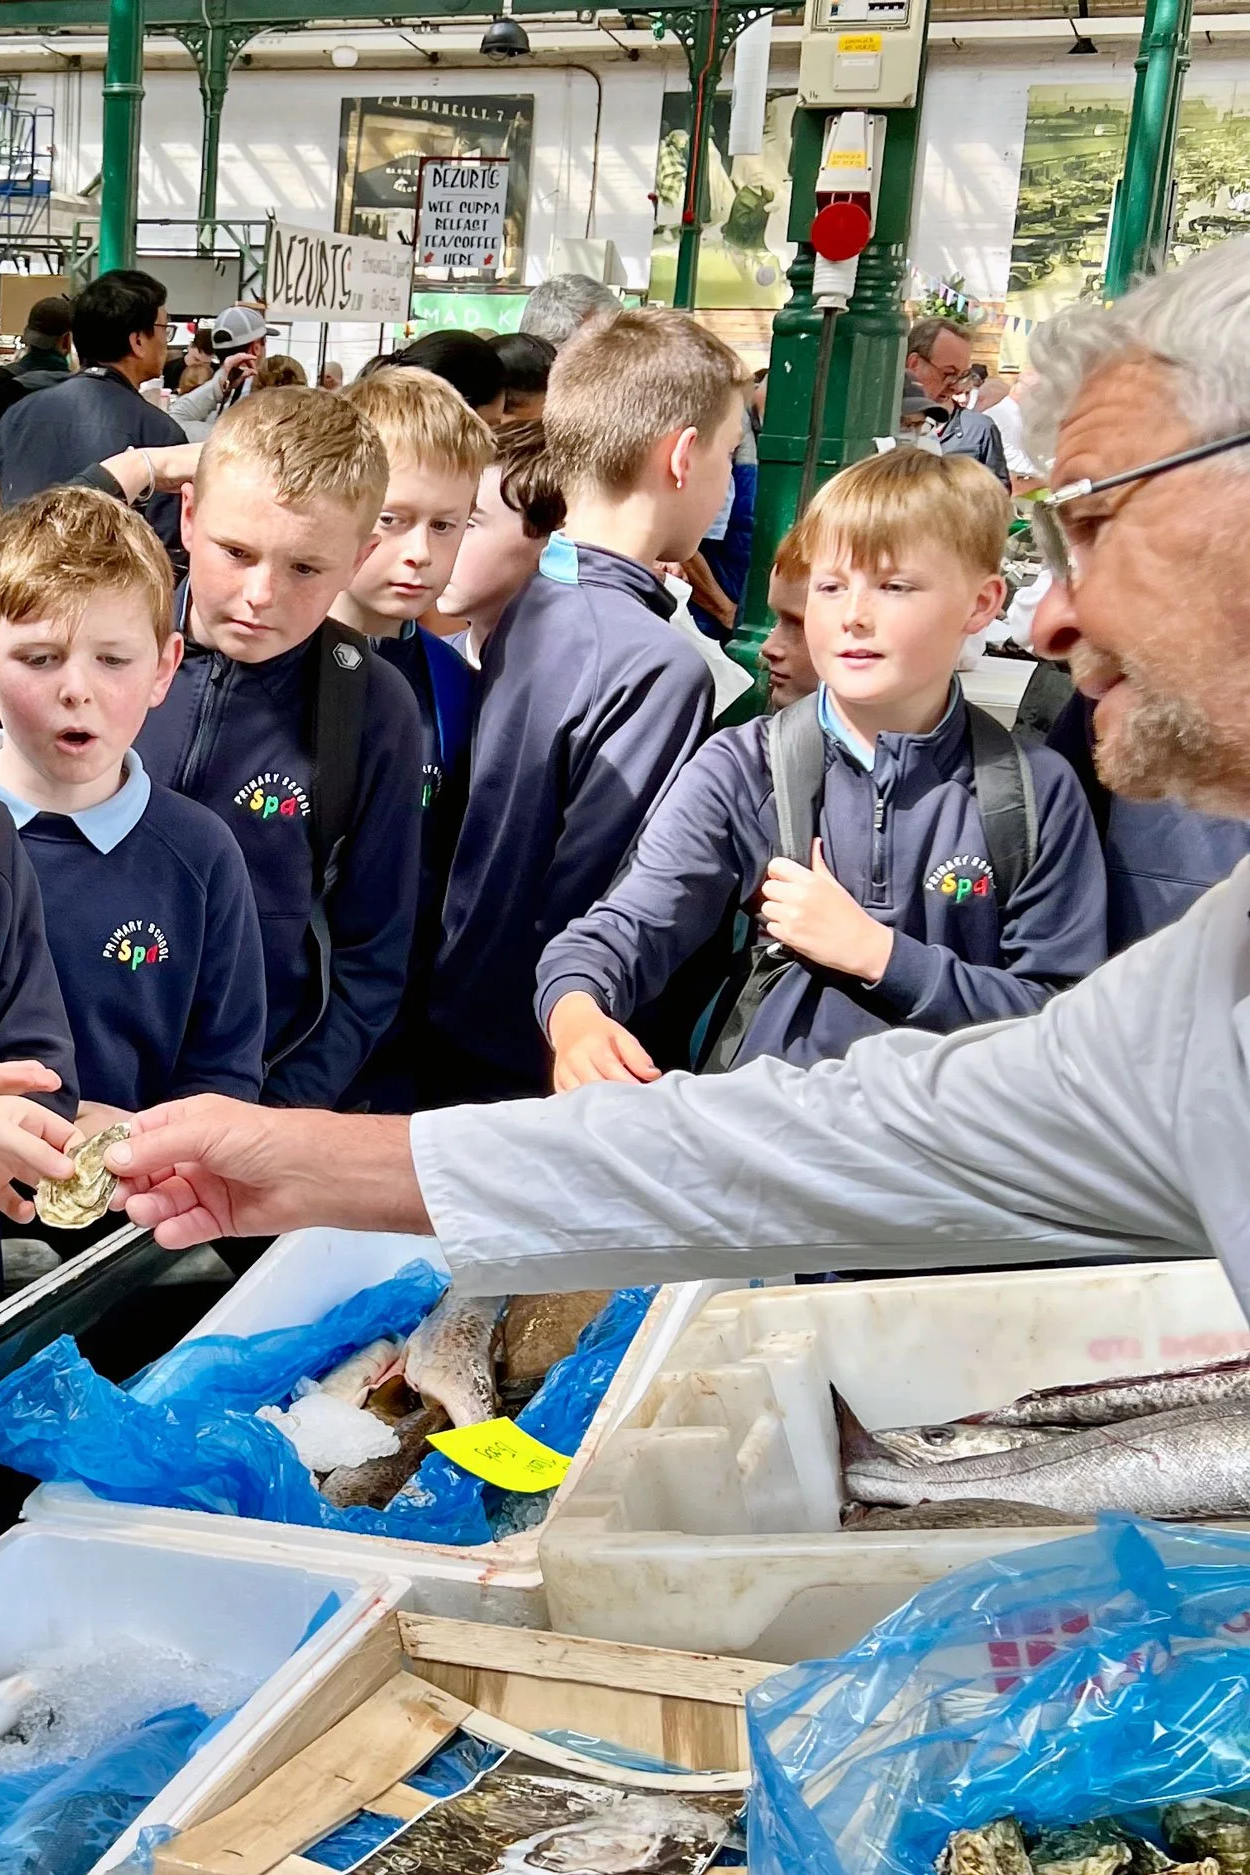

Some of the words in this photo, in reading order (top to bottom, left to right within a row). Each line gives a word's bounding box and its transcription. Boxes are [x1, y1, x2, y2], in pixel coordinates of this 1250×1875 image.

[428, 201, 453, 213] WEE
[459, 201, 500, 215] CUPPA
[435, 218, 490, 232] BELFAST
[424, 235, 499, 249] TEA/COFFEE
[443, 253, 474, 266] HERE
[272, 230, 352, 310] DEZURTS
[423, 307, 480, 327] MAD
[234, 773, 279, 805] PRIMARY
[282, 776, 311, 816] SCHOOL
[102, 920, 142, 958] PRIMARY
[148, 923, 169, 962] SCHOOL
